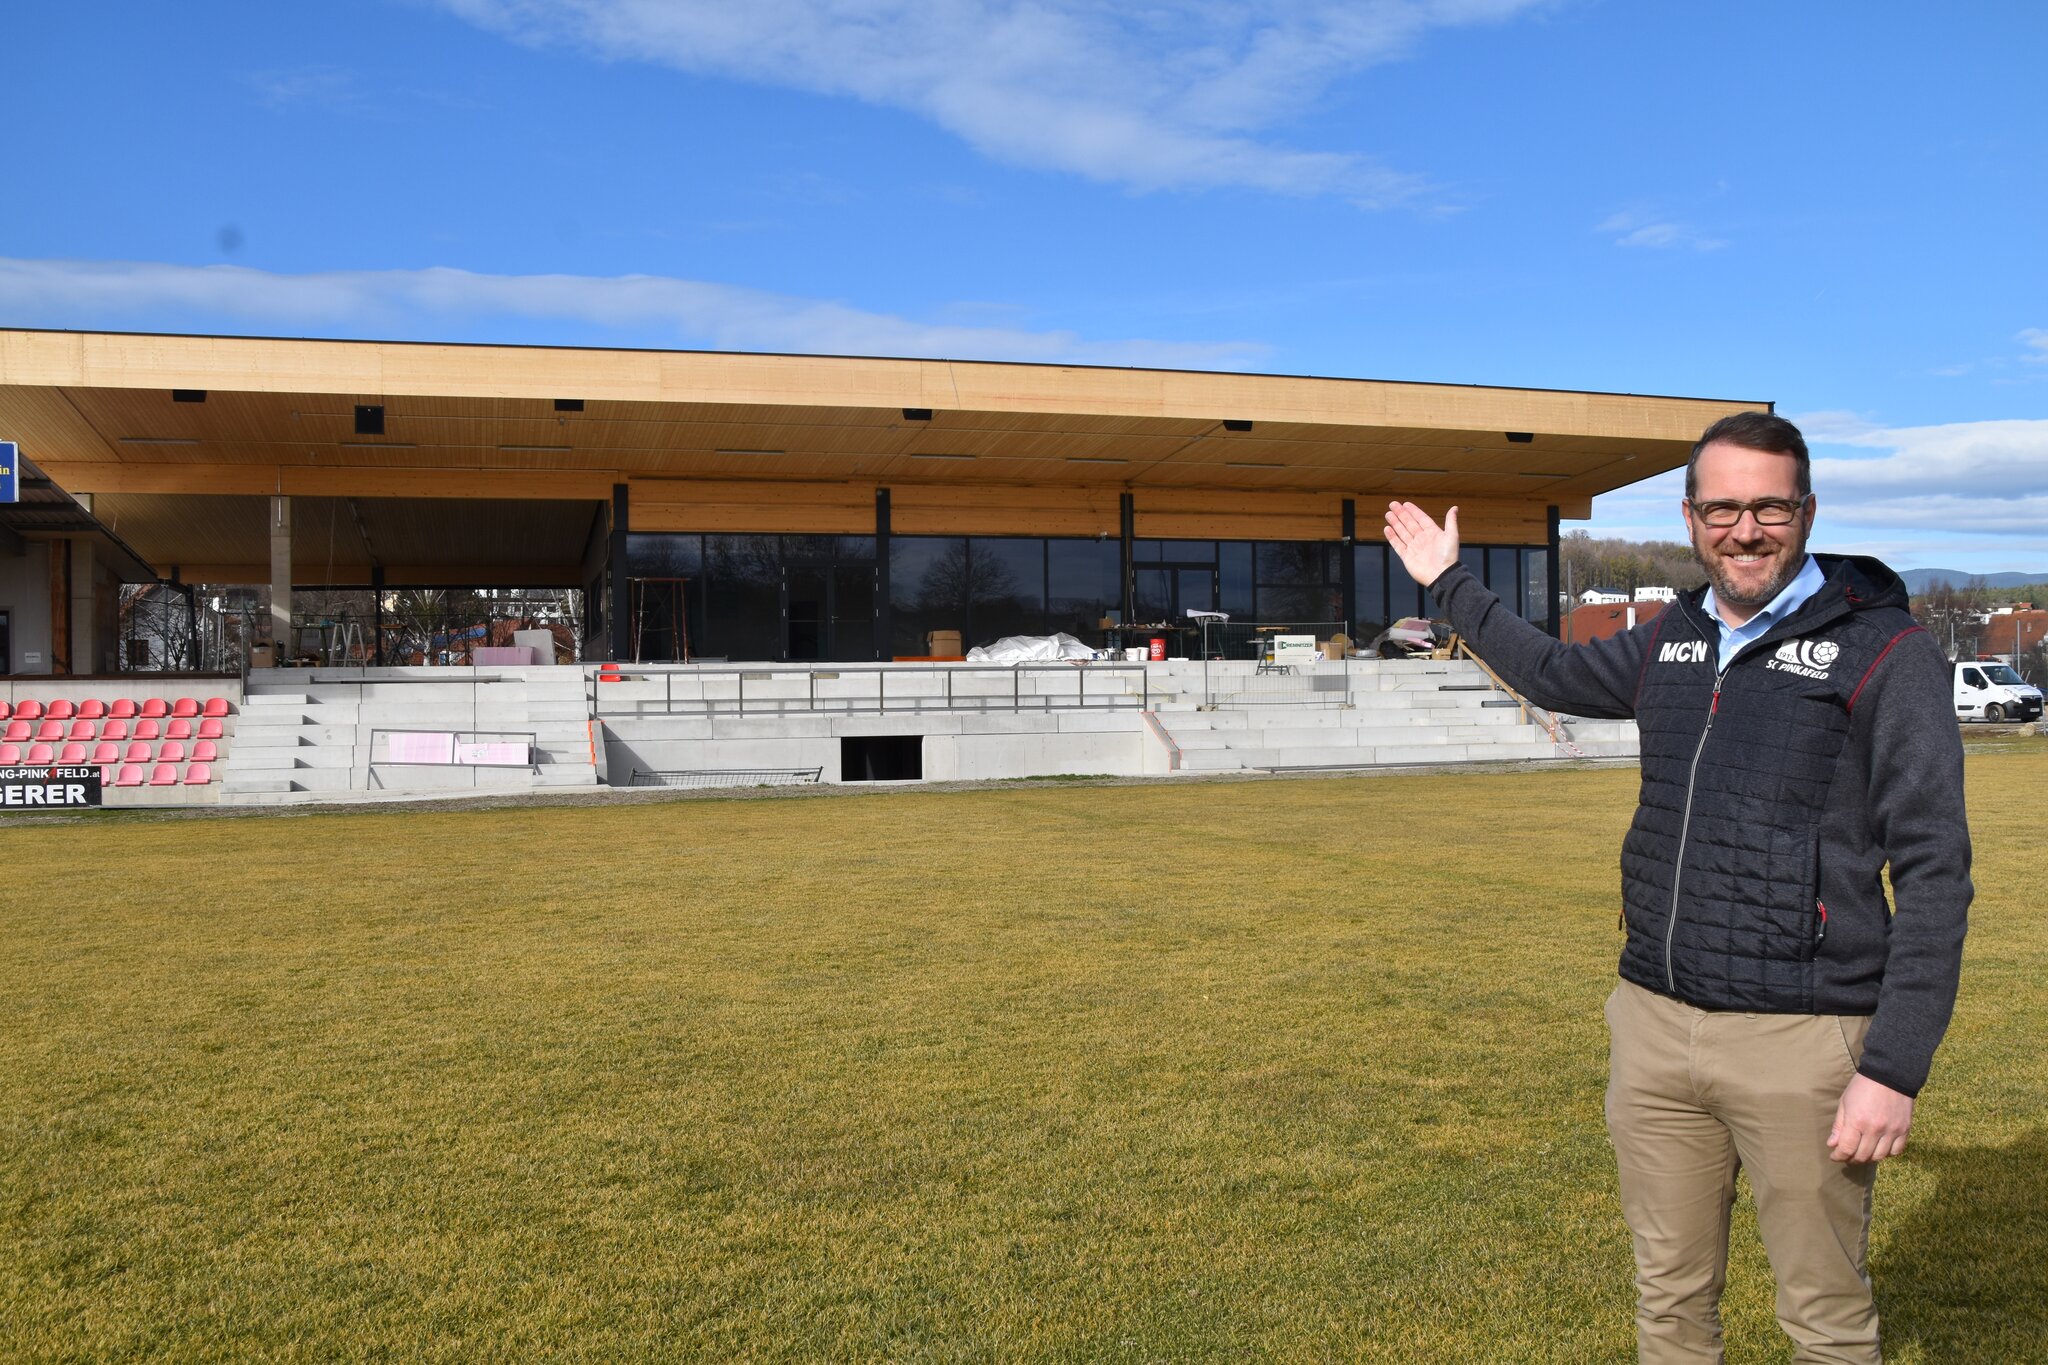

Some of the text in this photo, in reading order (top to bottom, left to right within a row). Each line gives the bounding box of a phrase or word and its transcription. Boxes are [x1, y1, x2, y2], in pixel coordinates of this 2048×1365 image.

[1779, 651, 1795, 662] 1912
[1765, 659, 1829, 680] SC PINKAFELD
[0, 784, 87, 805] ERER
